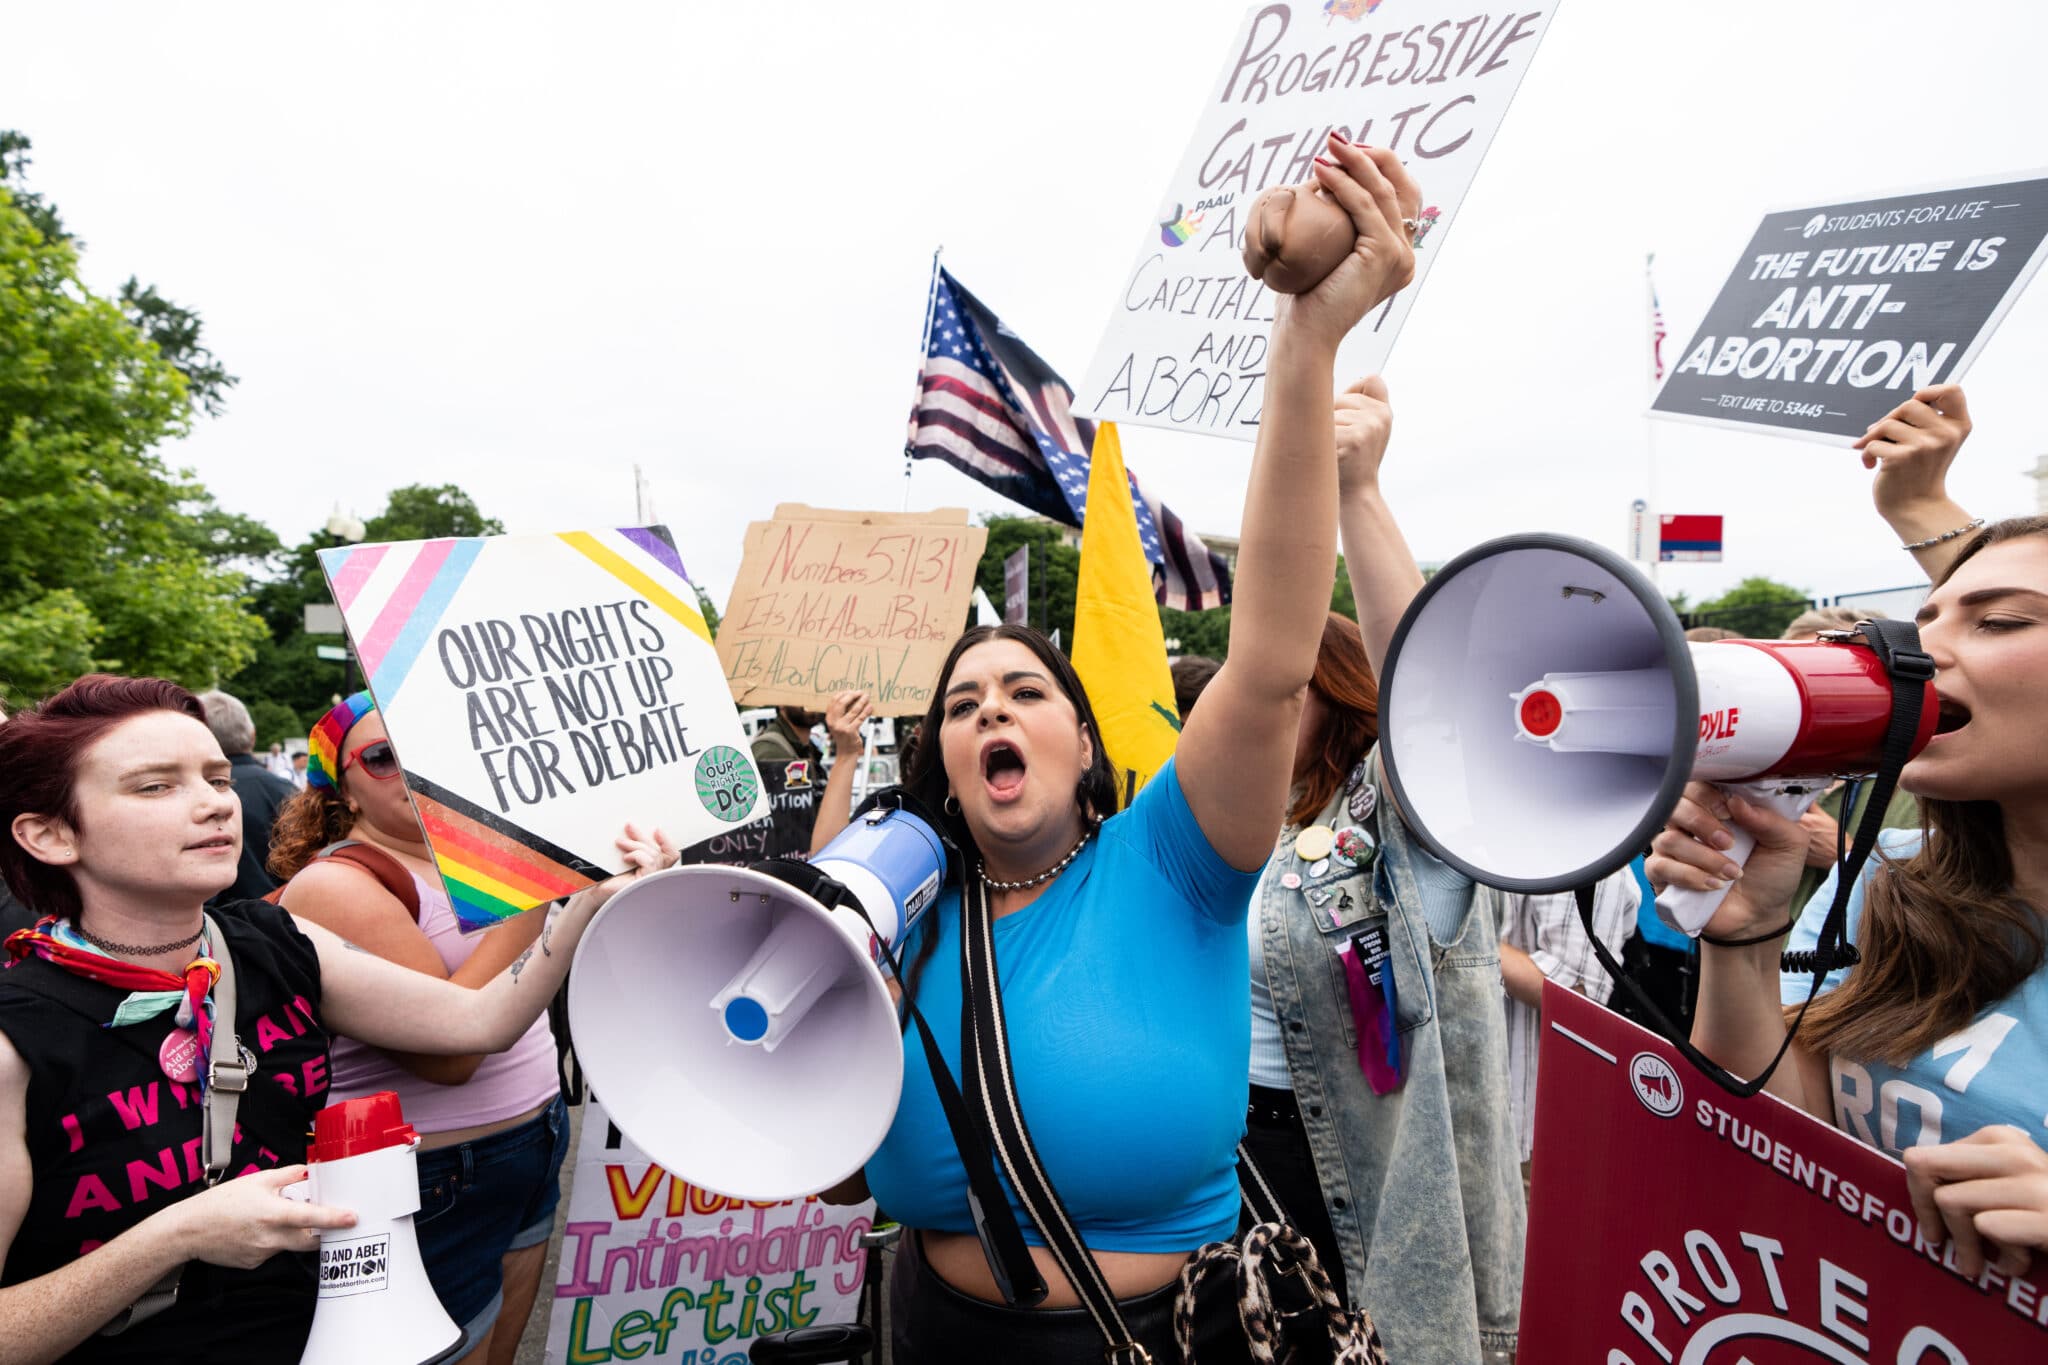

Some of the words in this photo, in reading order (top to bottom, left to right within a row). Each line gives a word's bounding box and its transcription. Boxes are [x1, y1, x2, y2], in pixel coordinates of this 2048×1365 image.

[1220, 3, 1542, 104] PROGRESSIVE
[1198, 95, 1476, 194] CATHIC
[1195, 192, 1235, 212] PAAU
[1823, 209, 1904, 233] STUDENTS
[1903, 205, 1945, 225] FOR
[1945, 200, 1990, 221] LIFE
[1749, 251, 1811, 281] THE
[1807, 240, 1954, 278] FUTURE
[1954, 236, 2007, 272] IS
[1752, 283, 1906, 329] ANTI-
[1190, 332, 1267, 371] AND
[1676, 335, 1957, 391] ABORTION
[1717, 394, 1744, 408] TEXT
[1742, 396, 1768, 412] LIFE
[1766, 400, 1784, 413] TO
[1783, 402, 1825, 418] 53445
[761, 523, 868, 588] Numbers
[787, 591, 832, 639] Not
[825, 594, 893, 640] About
[438, 620, 531, 689] OUR
[520, 600, 665, 673] RIGHTS
[763, 640, 819, 686] About
[877, 644, 932, 703] Women
[466, 679, 556, 750] ARE
[543, 663, 626, 730] NOT
[626, 656, 674, 707] UP
[480, 740, 576, 814] FOR
[573, 703, 701, 788] DEBATE
[706, 760, 735, 778] OUR
[710, 771, 741, 789] RIGHTS
[715, 783, 747, 812] DC
[709, 830, 768, 855] ONLY
[1364, 938, 1382, 950] FROM
[165, 1052, 184, 1072] Aid
[331, 1248, 353, 1263] AND
[355, 1242, 387, 1259] ABET
[555, 1203, 874, 1298] Intimidating
[566, 1270, 821, 1365] Leftist
